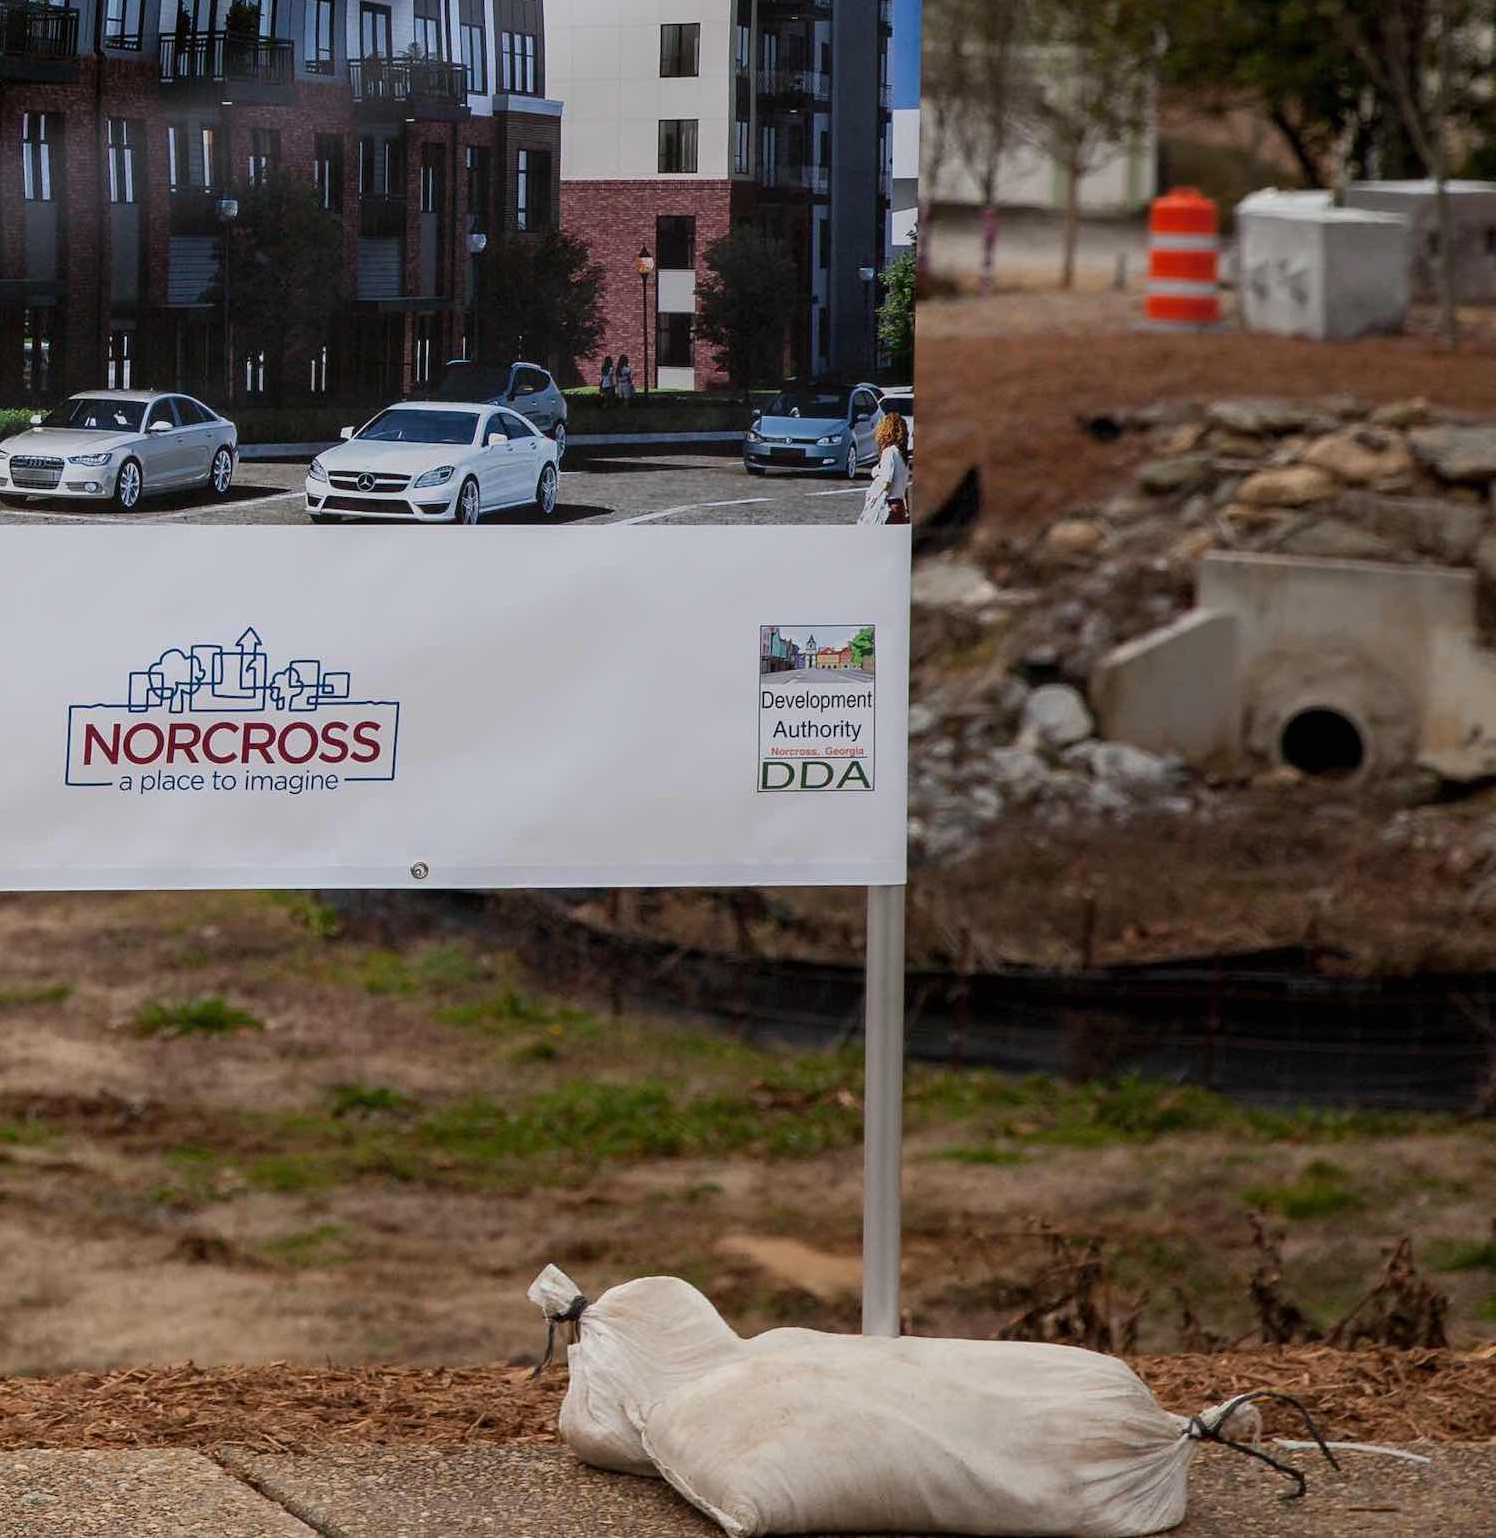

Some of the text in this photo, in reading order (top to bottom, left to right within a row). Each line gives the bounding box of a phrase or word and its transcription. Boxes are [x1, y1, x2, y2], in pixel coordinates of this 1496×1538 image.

[761, 691, 873, 713] Development
[83, 720, 383, 766] NORCROSS
[772, 720, 862, 742] Authority
[825, 747, 864, 758] Georgia
[119, 769, 340, 795] a place to imagine
[761, 760, 872, 790] DDA
